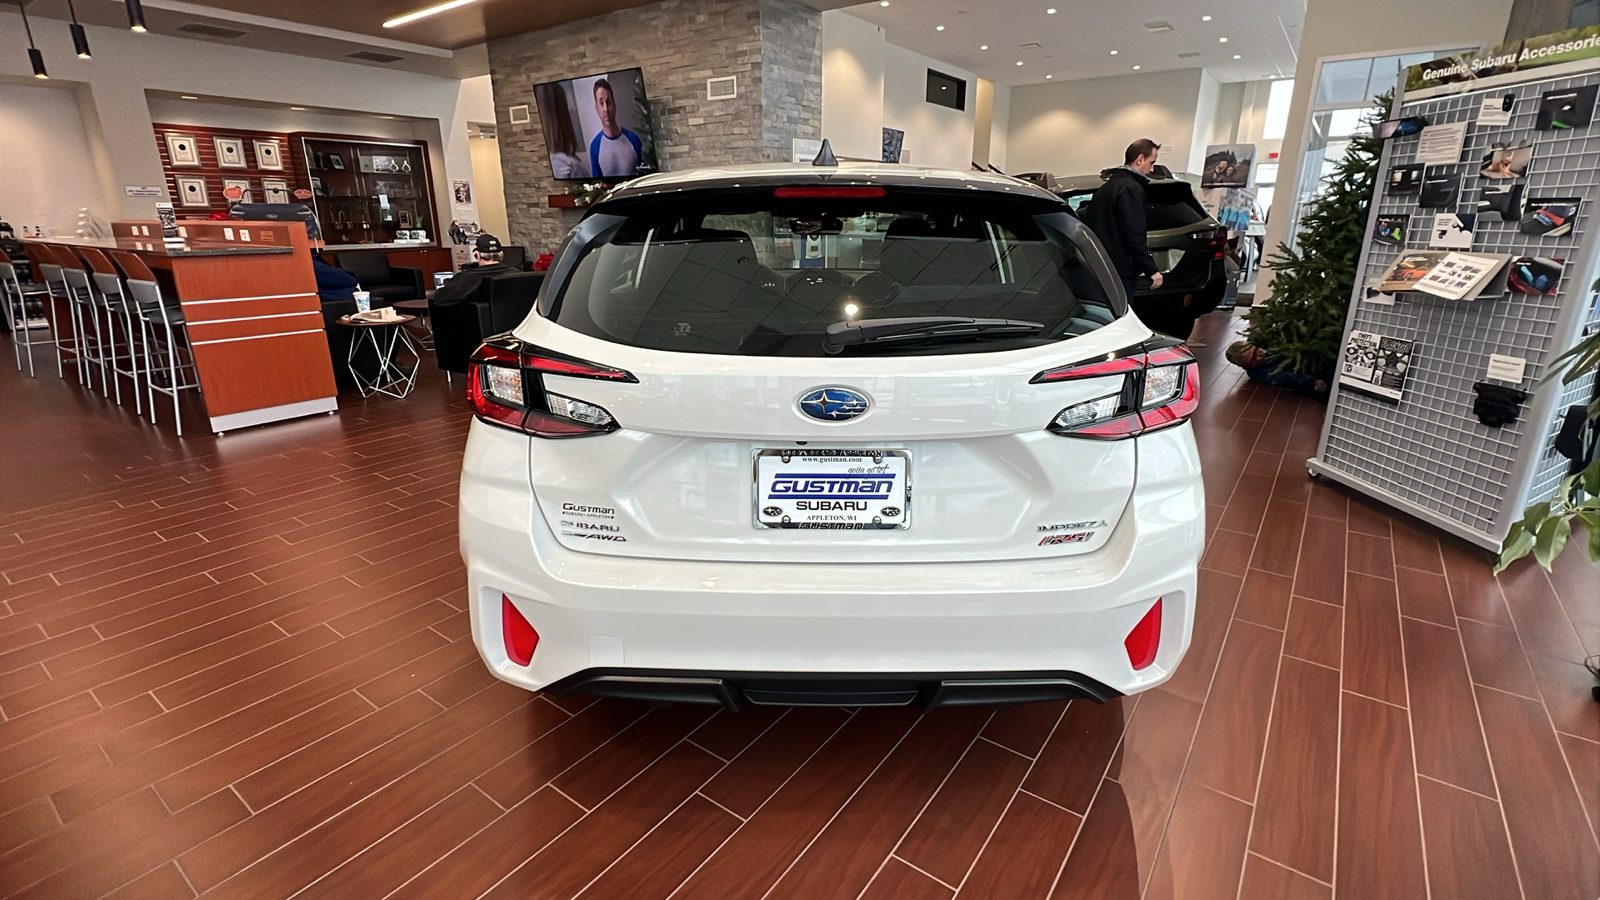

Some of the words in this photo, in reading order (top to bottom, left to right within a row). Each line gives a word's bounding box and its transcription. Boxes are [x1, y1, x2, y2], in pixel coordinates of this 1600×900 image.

[1422, 64, 1467, 80] Genuine
[1471, 52, 1517, 71] Subaru
[796, 501, 868, 511] SUBARU
[807, 514, 846, 522] APPLETON,
[560, 520, 620, 532] SUBARU
[1037, 519, 1108, 533] IMPREZA
[586, 533, 627, 542] AWD
